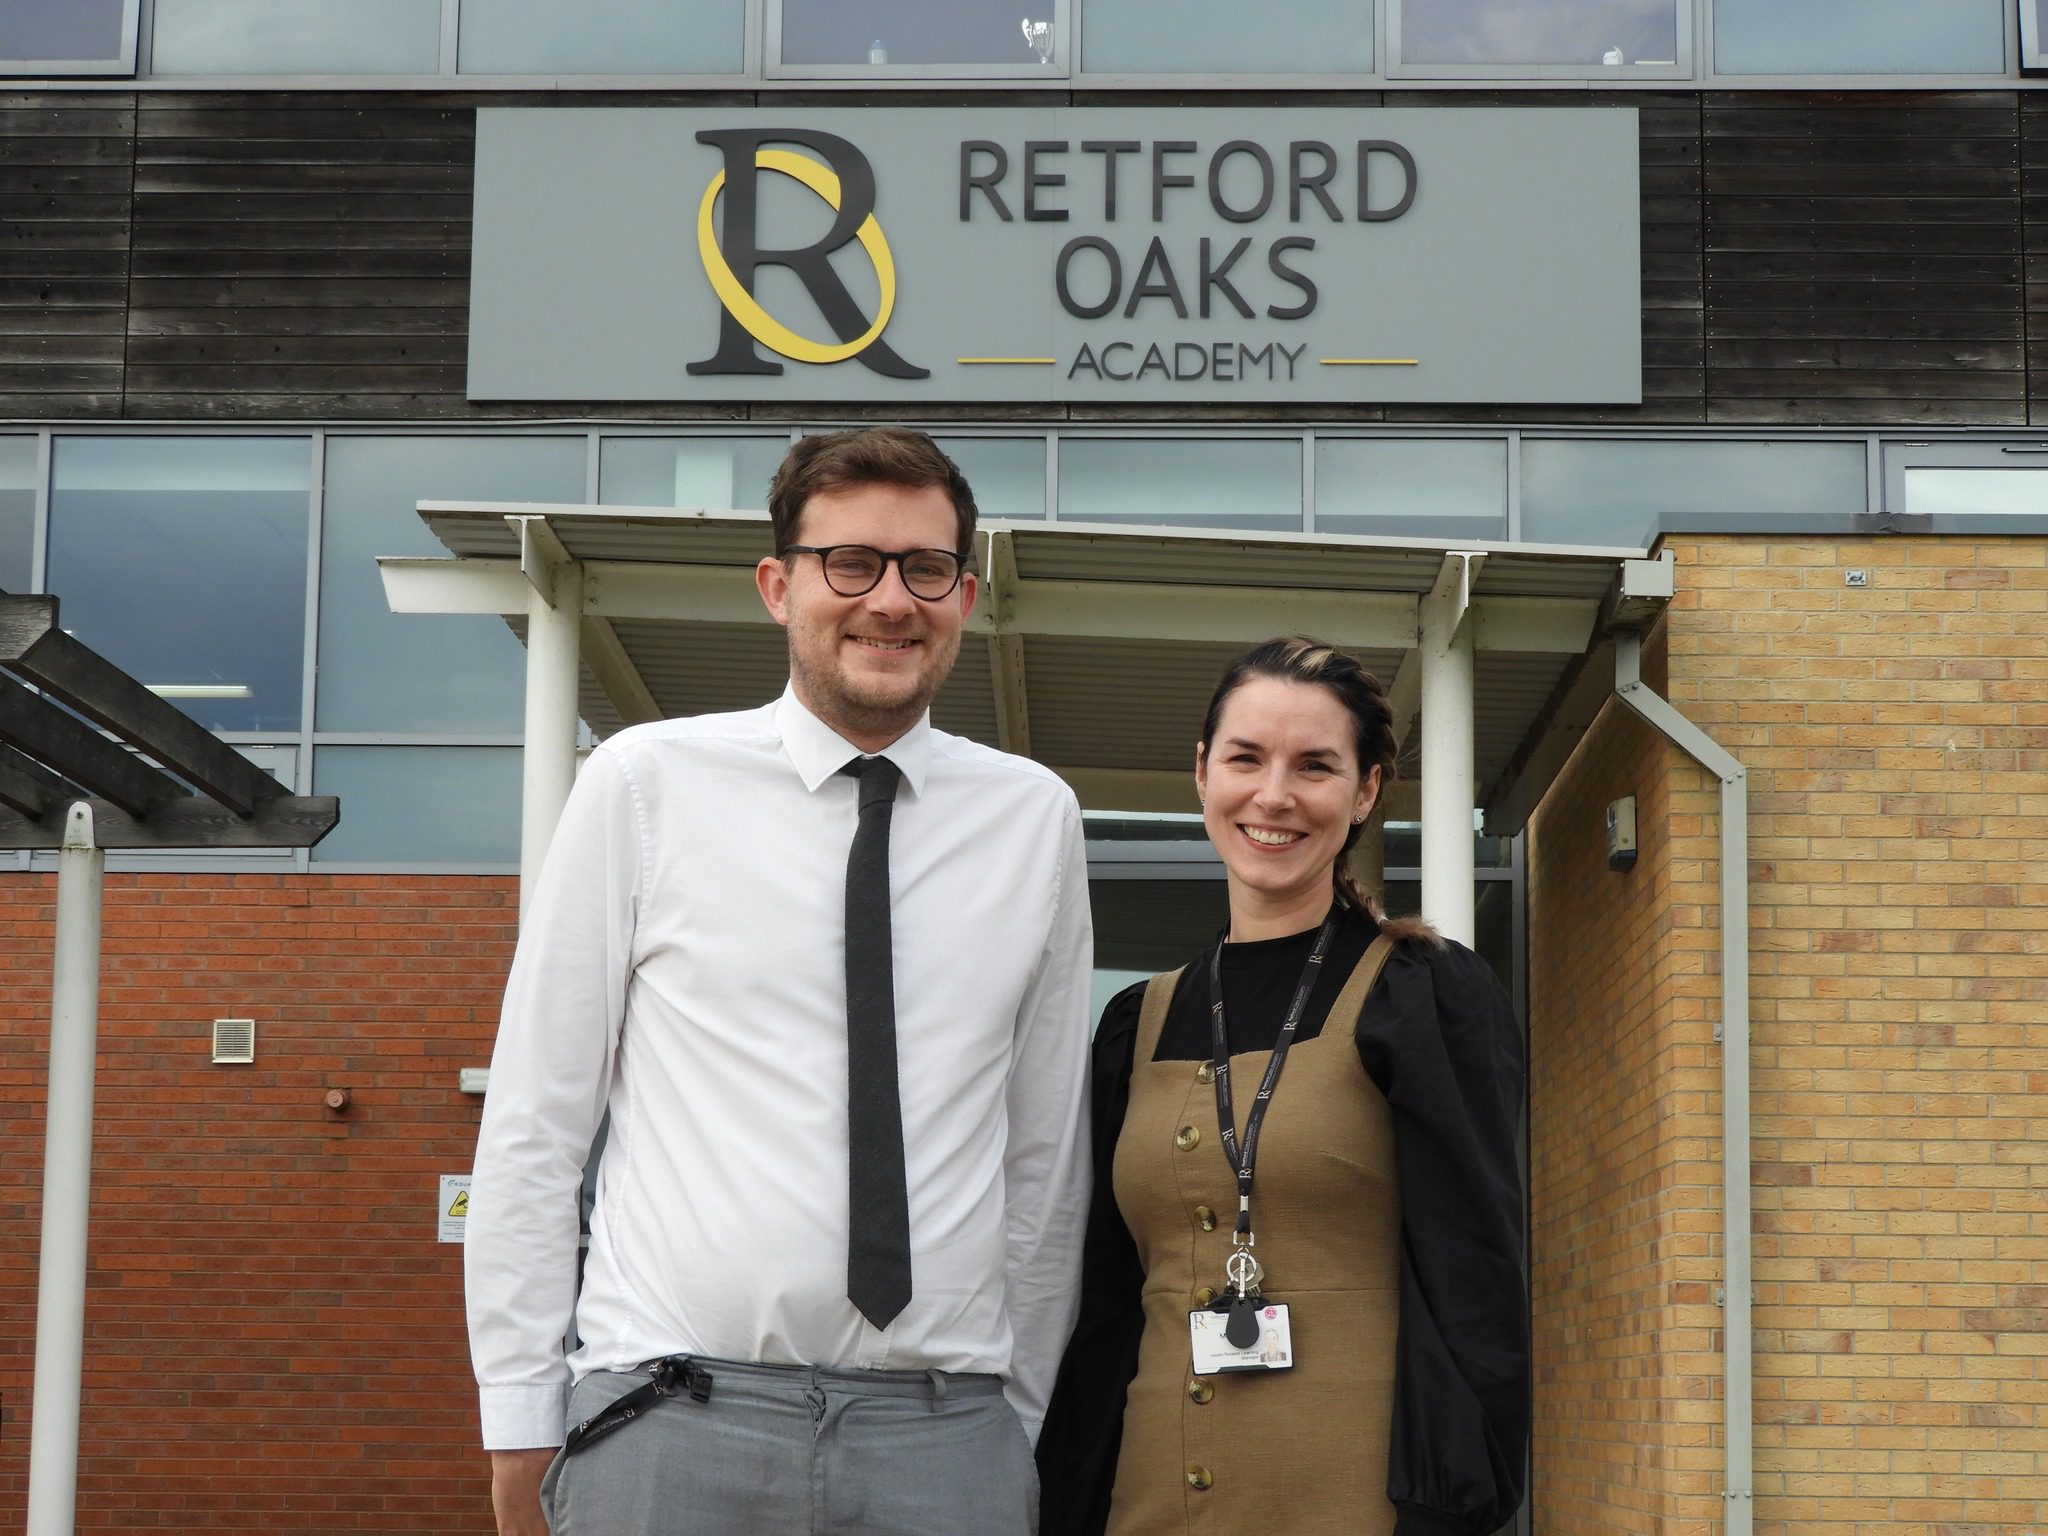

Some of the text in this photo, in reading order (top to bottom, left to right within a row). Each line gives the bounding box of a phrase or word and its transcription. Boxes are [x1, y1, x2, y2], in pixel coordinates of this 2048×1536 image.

[960, 140, 1418, 223] RETFORD
[1056, 235, 1319, 319] OAKS
[1068, 342, 1307, 381] ACADEMY
